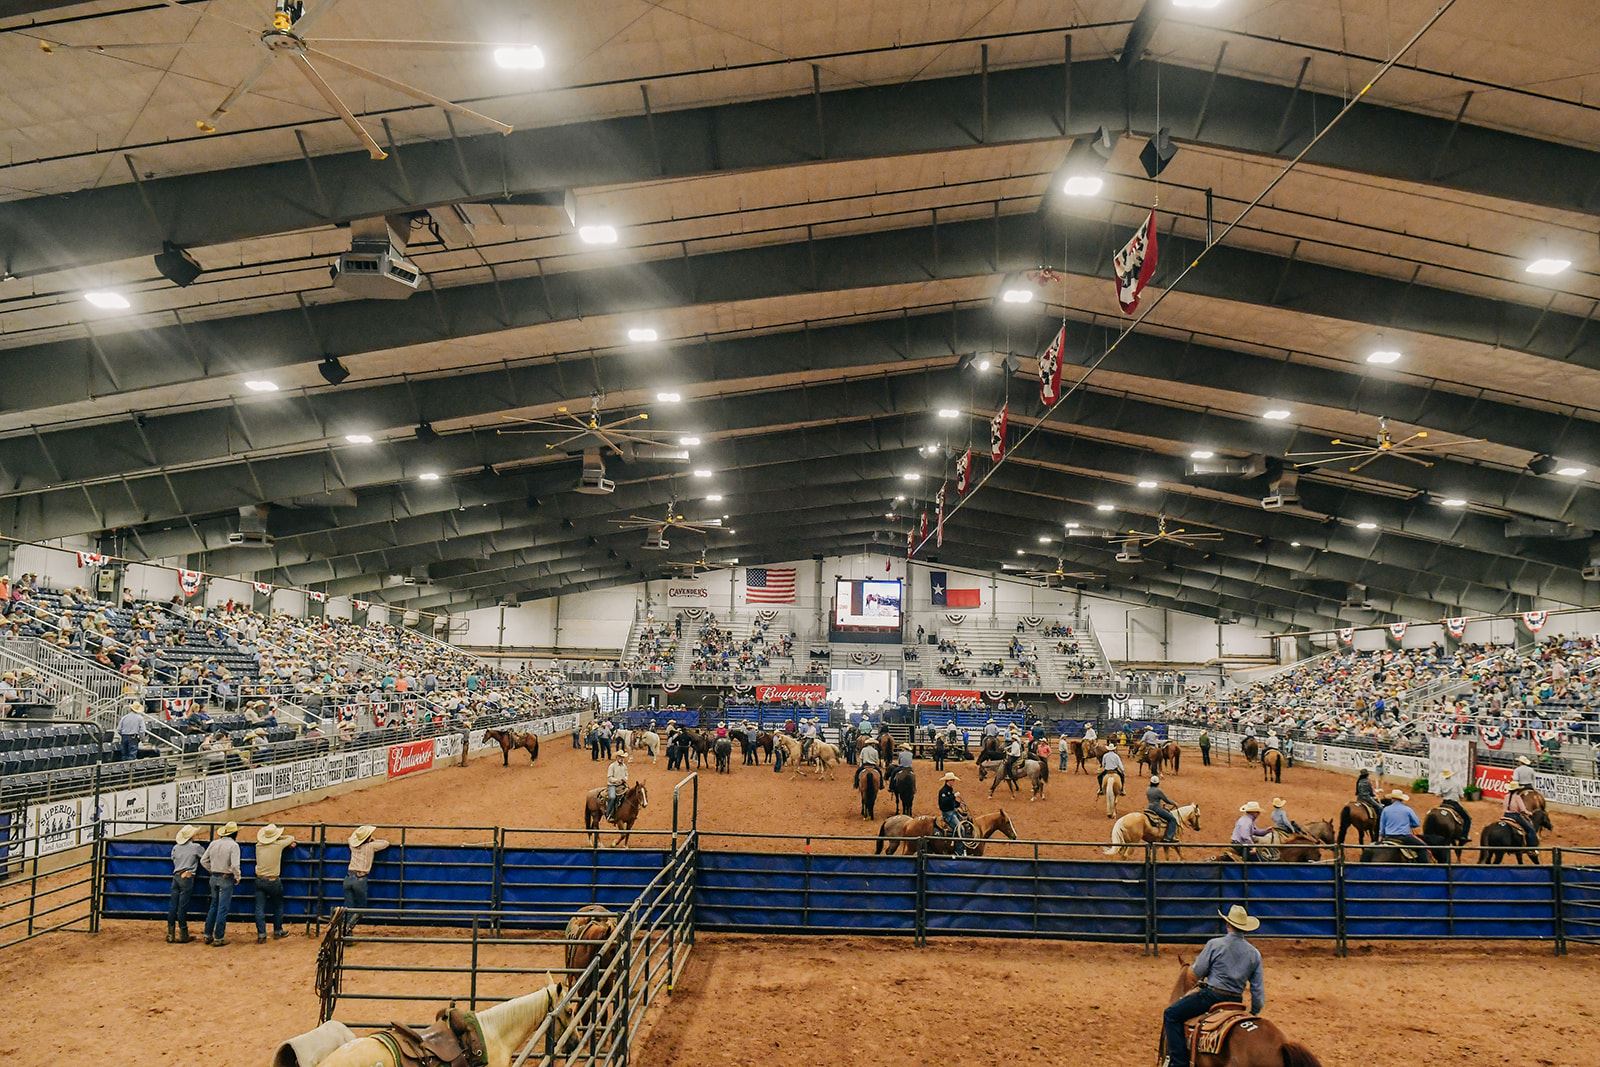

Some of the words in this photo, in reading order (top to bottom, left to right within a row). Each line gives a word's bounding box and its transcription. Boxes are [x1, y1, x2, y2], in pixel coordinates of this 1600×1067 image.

[391, 744, 432, 773] Budweiser
[275, 767, 292, 775] JACKSON
[255, 772, 273, 787] VISION
[275, 773, 291, 786] BROS.
[1476, 770, 1509, 793] dweis
[1535, 776, 1555, 790] TEJON
[180, 780, 204, 794] COMMUNITY
[292, 782, 309, 794] SHAW
[1556, 784, 1579, 796] SERVICES
[179, 792, 204, 807] BROADCAST
[41, 804, 76, 826] SUPERIOR
[162, 808, 174, 816] BANK
[179, 805, 204, 819] PARTNERS
[42, 843, 55, 853] Land
[55, 840, 75, 849] Auction
